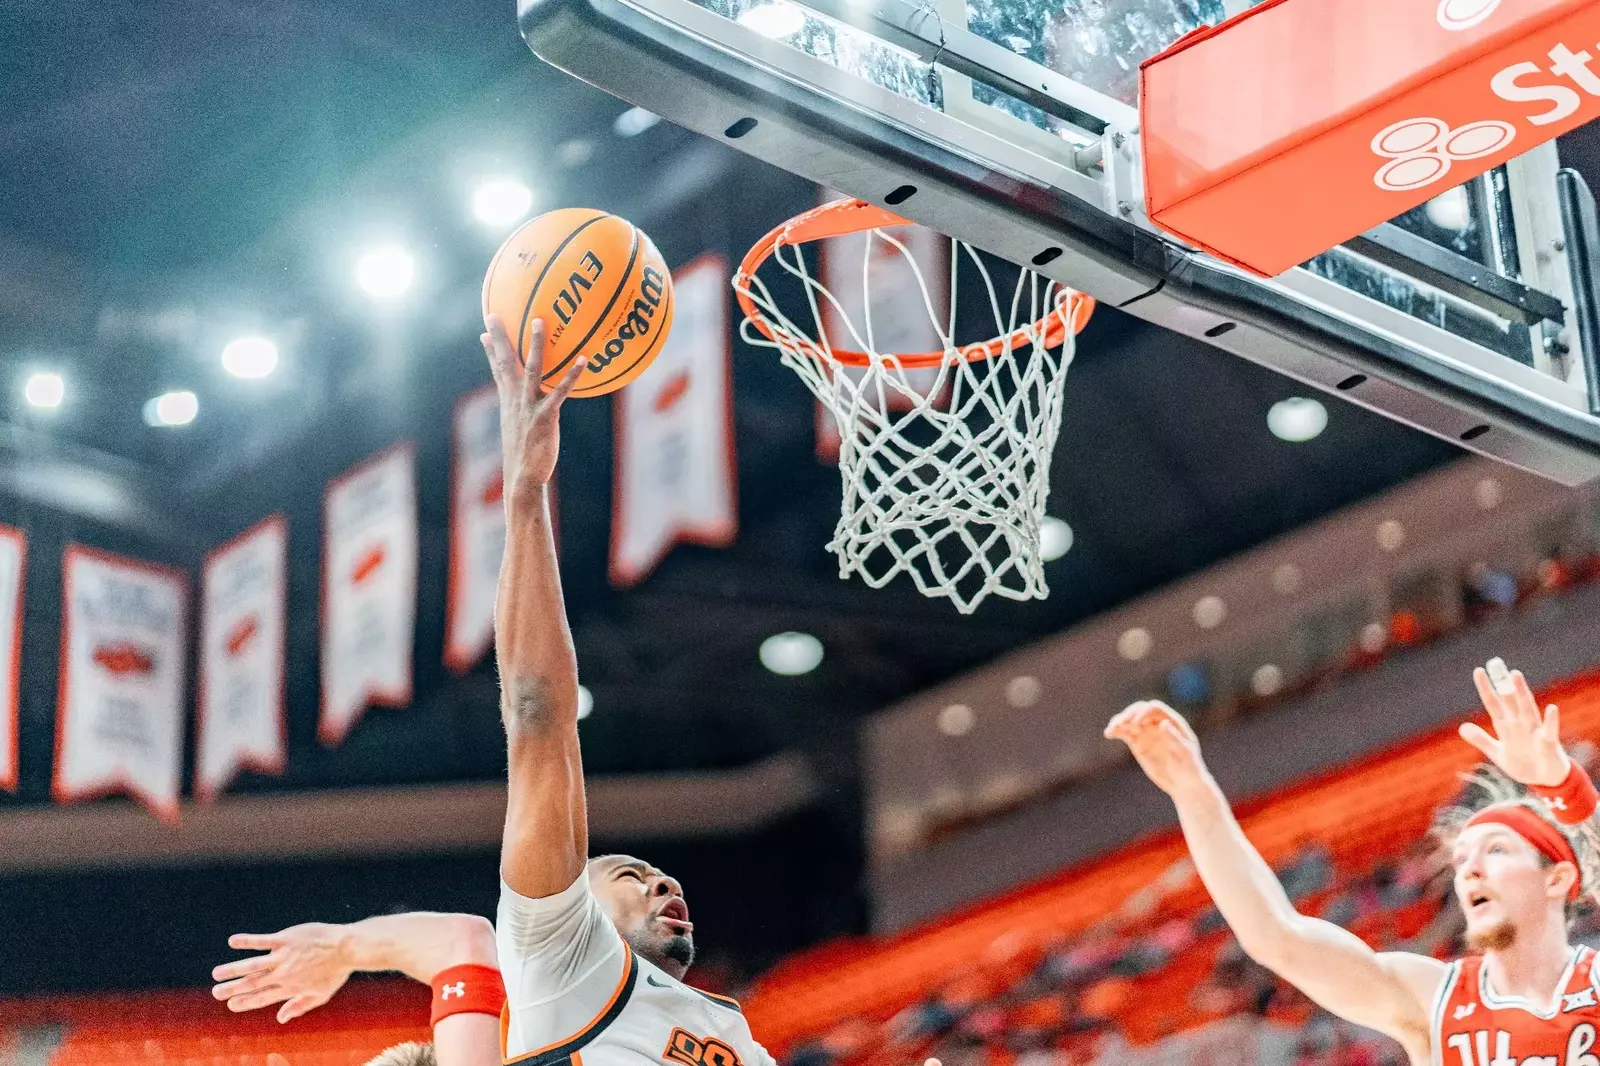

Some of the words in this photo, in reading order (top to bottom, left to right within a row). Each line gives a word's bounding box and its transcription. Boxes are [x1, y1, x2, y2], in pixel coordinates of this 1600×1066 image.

[1490, 42, 1600, 126] St
[552, 250, 604, 326] EVO
[586, 265, 663, 374] Wilson
[550, 324, 565, 348] NXT
